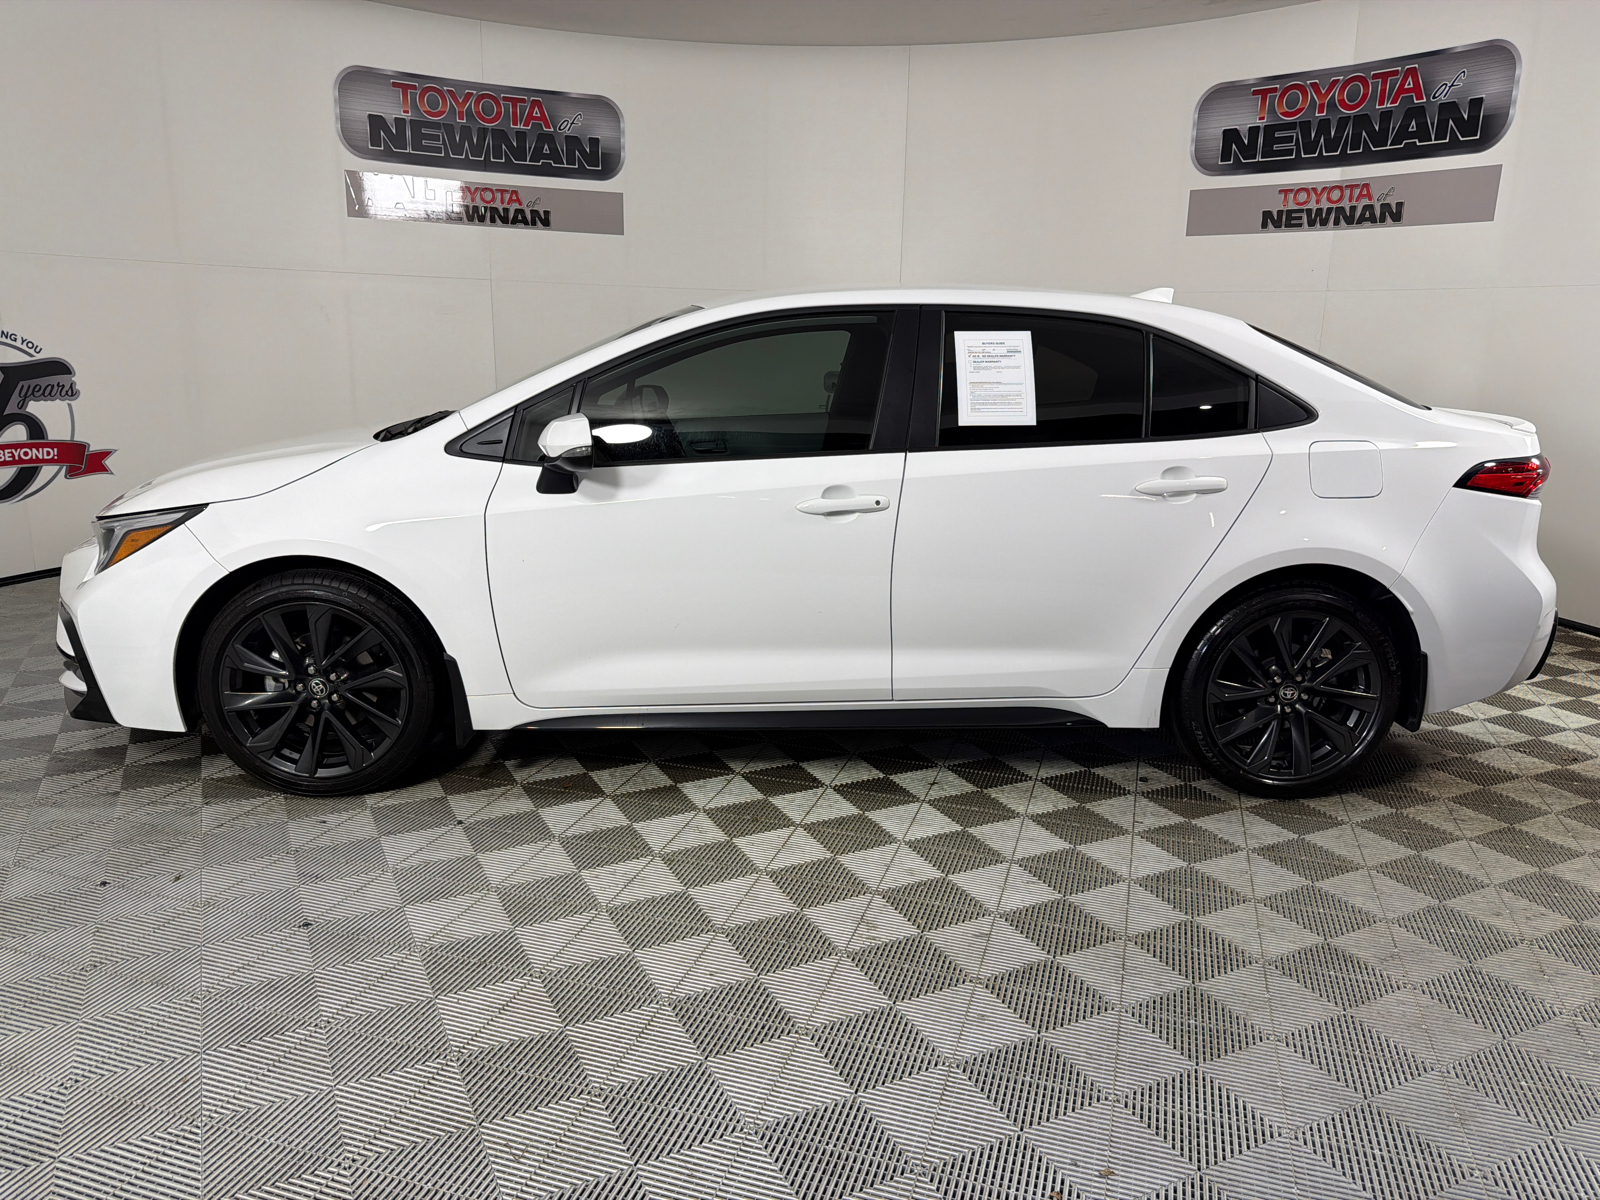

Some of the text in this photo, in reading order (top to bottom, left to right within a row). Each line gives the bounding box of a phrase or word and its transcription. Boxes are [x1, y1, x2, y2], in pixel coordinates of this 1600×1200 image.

[391, 80, 583, 132] TOYOTA of
[1251, 65, 1467, 121] TOYOTA of
[367, 113, 602, 170] NEWNAN
[1218, 95, 1486, 165] NEWNAN
[460, 186, 541, 208] YOTA of
[1278, 182, 1395, 207] TOYOTA of
[1260, 201, 1406, 231] NEWNAN
[21, 336, 43, 354] YOU
[16, 380, 78, 410] years
[0, 447, 58, 461] BEYOND!
